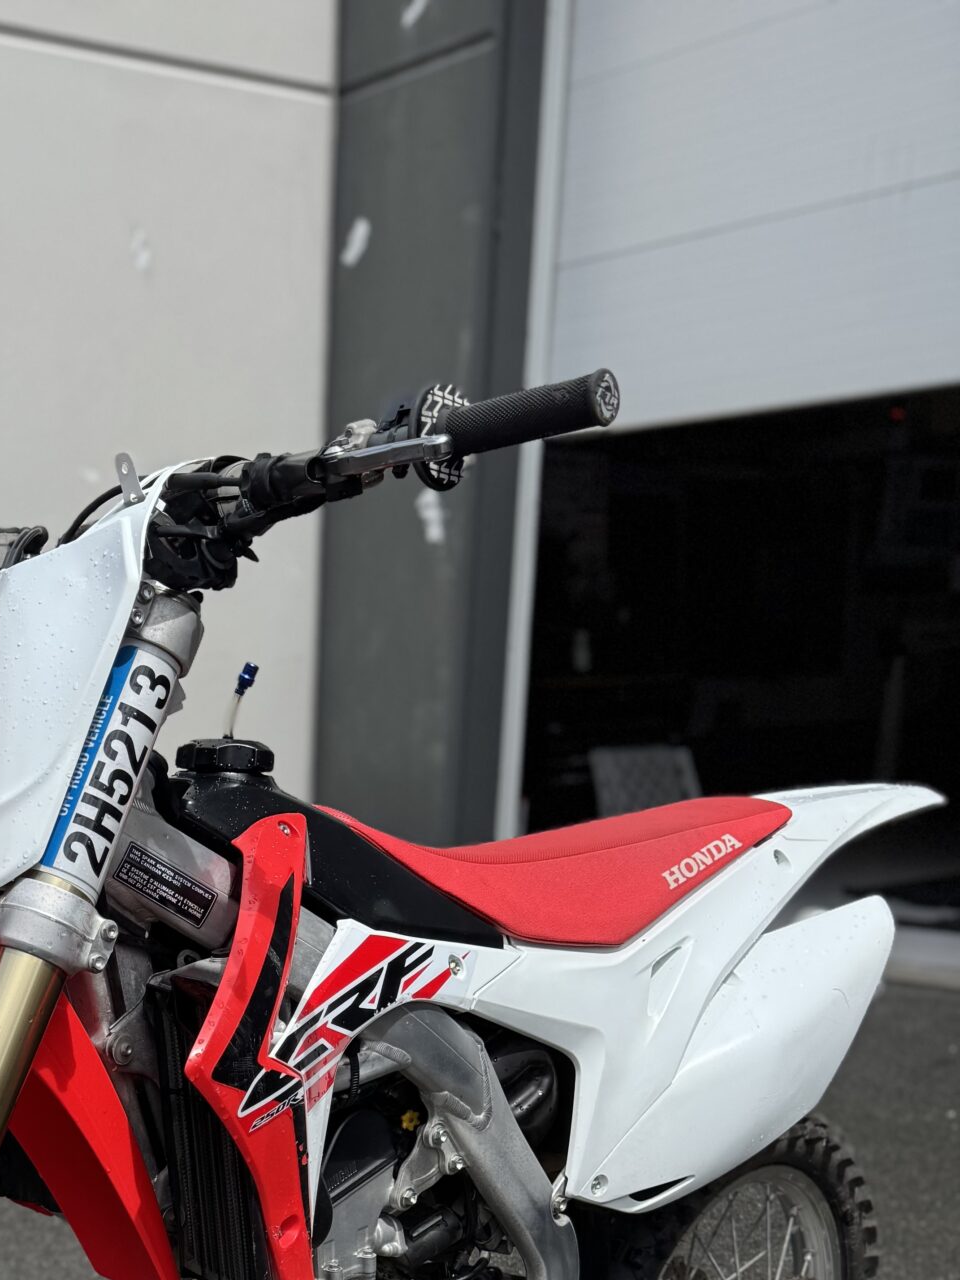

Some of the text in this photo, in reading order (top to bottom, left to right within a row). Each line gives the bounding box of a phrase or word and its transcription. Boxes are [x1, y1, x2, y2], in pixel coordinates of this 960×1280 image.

[67, 747, 90, 790] ROAD
[84, 694, 114, 750] VEHICLE
[63, 664, 172, 879] 2H5213
[139, 859, 162, 875] CANADIAN
[141, 854, 155, 865] SPARK
[155, 863, 174, 877] IGNITION
[174, 874, 191, 887] SYSTEM
[191, 884, 212, 899] COMPLIES
[661, 833, 743, 890] HONDA
[249, 1089, 305, 1132] 250R
